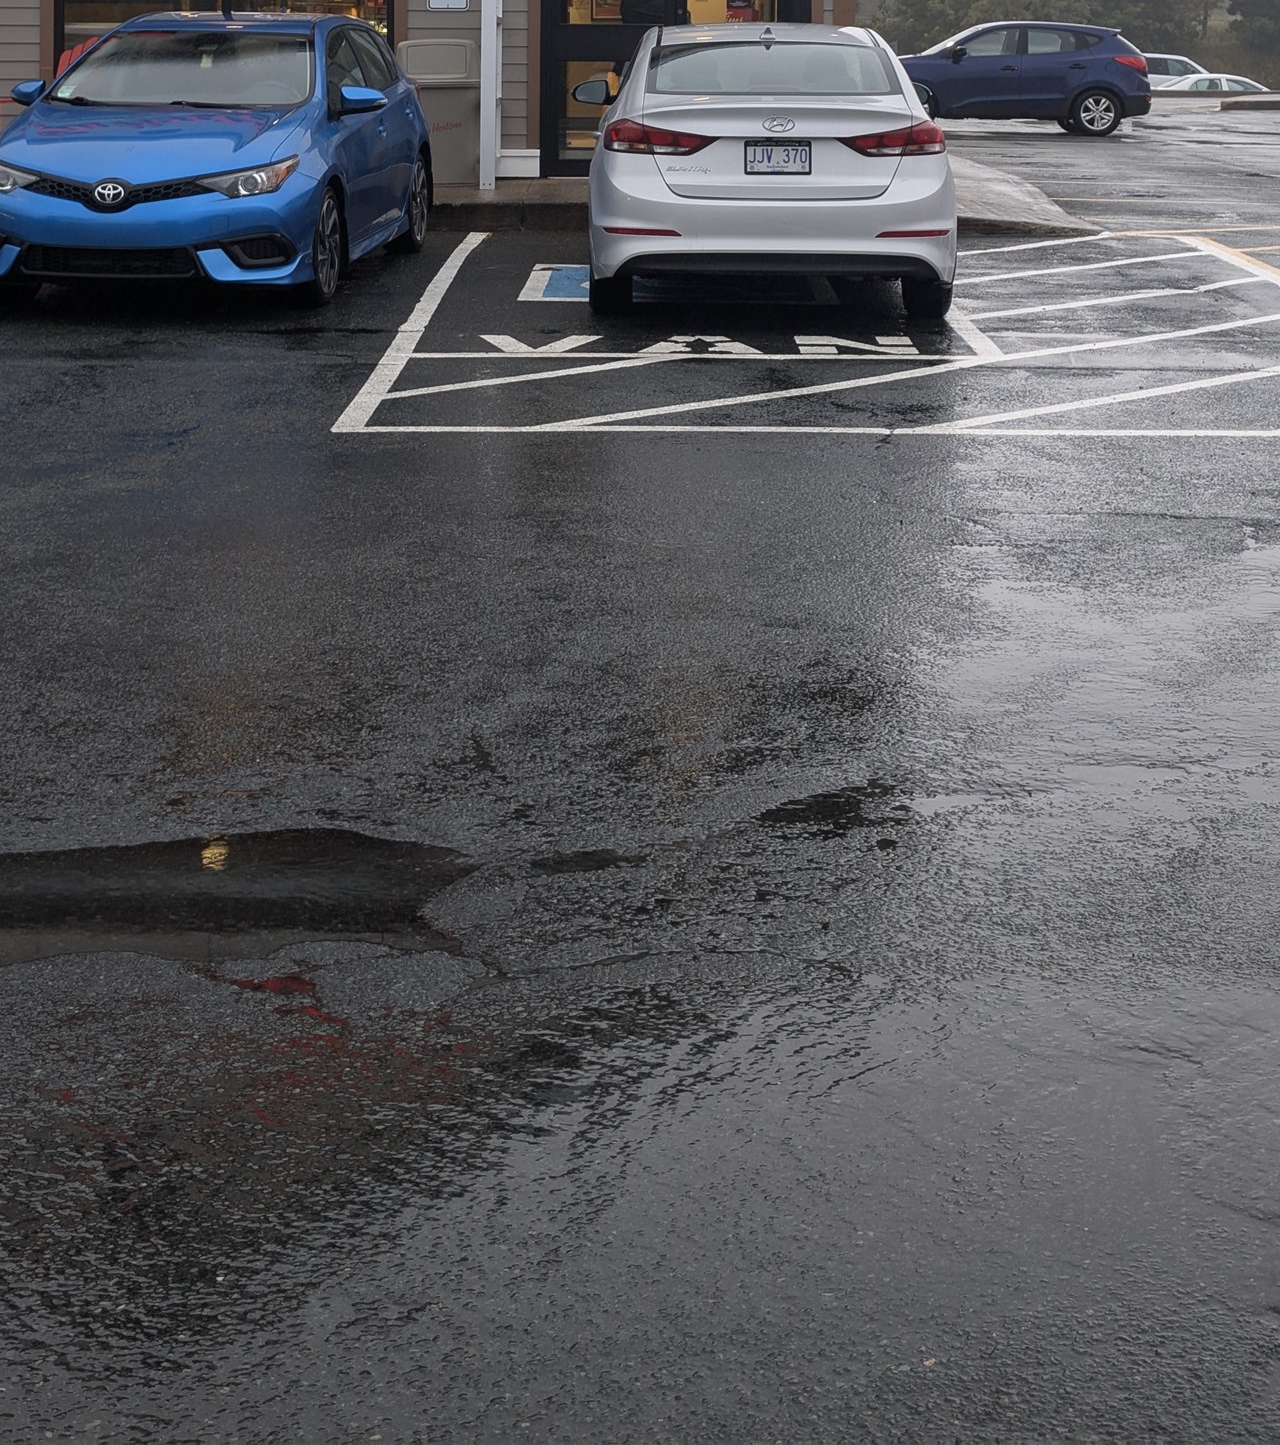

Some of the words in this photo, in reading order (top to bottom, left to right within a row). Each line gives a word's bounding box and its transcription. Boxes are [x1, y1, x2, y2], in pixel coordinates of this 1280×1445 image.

[748, 148, 773, 163] JJV
[782, 148, 807, 163] 370
[478, 334, 920, 354] VAN
